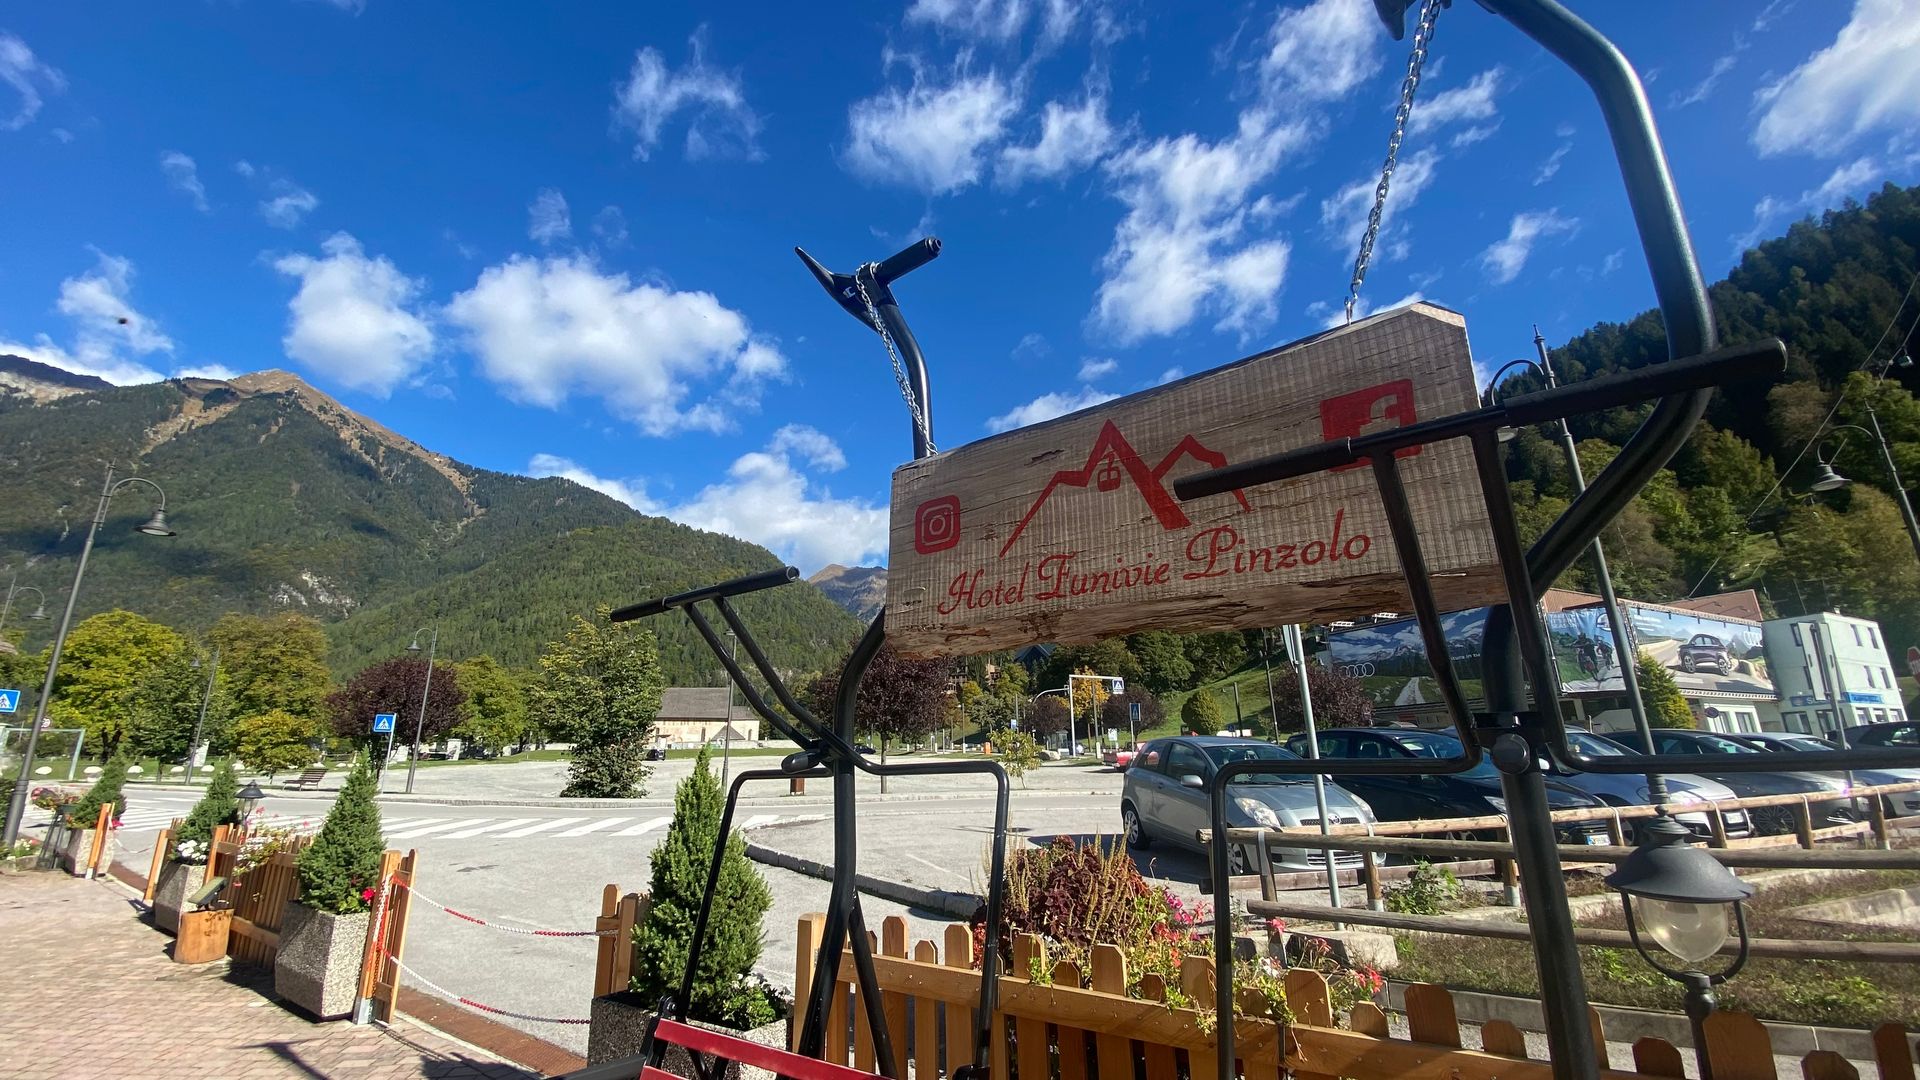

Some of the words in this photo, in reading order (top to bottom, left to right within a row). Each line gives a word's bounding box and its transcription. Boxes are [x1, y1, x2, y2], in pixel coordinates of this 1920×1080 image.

[937, 561, 1030, 615] Hotel
[1035, 551, 1170, 600] Funivie
[1183, 507, 1371, 580] Pinzolo
